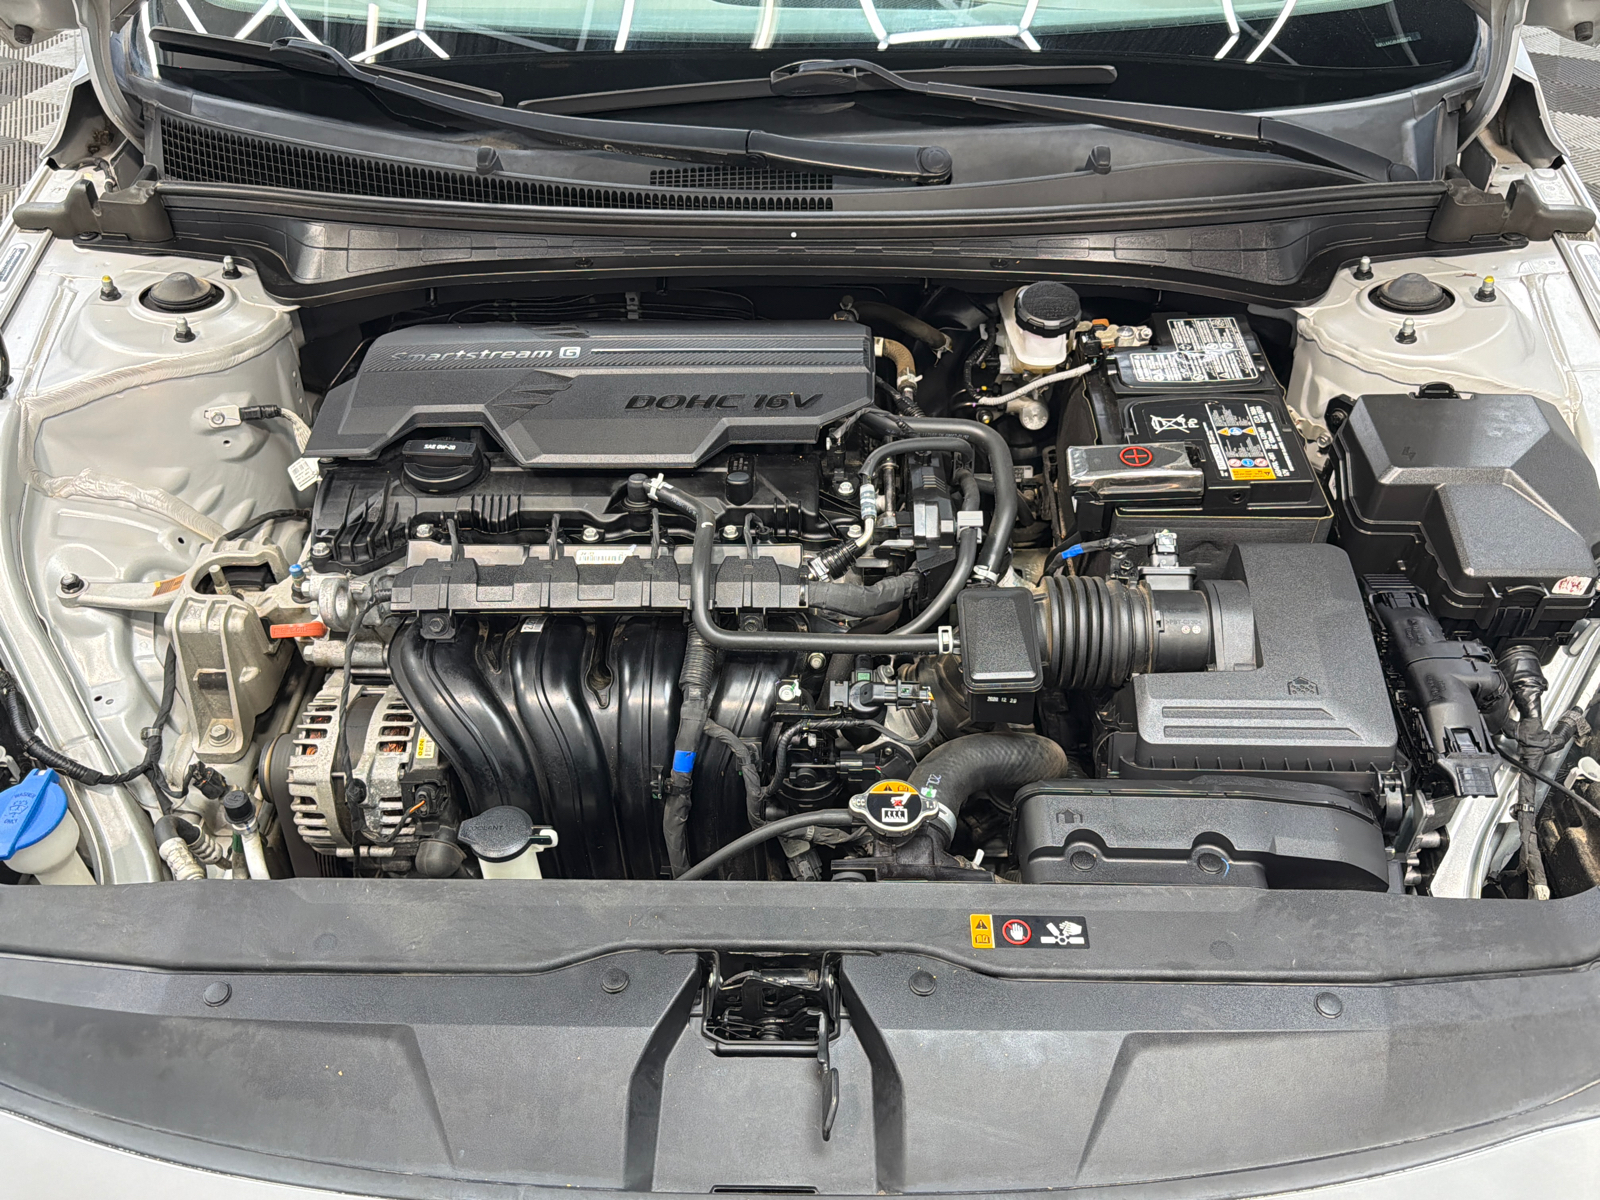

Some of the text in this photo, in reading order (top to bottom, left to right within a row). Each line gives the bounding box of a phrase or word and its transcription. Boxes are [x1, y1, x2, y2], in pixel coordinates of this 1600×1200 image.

[391, 347, 581, 362] Smartstream G
[625, 393, 824, 410] DOHC 16V
[1187, 418, 1200, 428] Pb
[925, 801, 936, 809] 1.1
